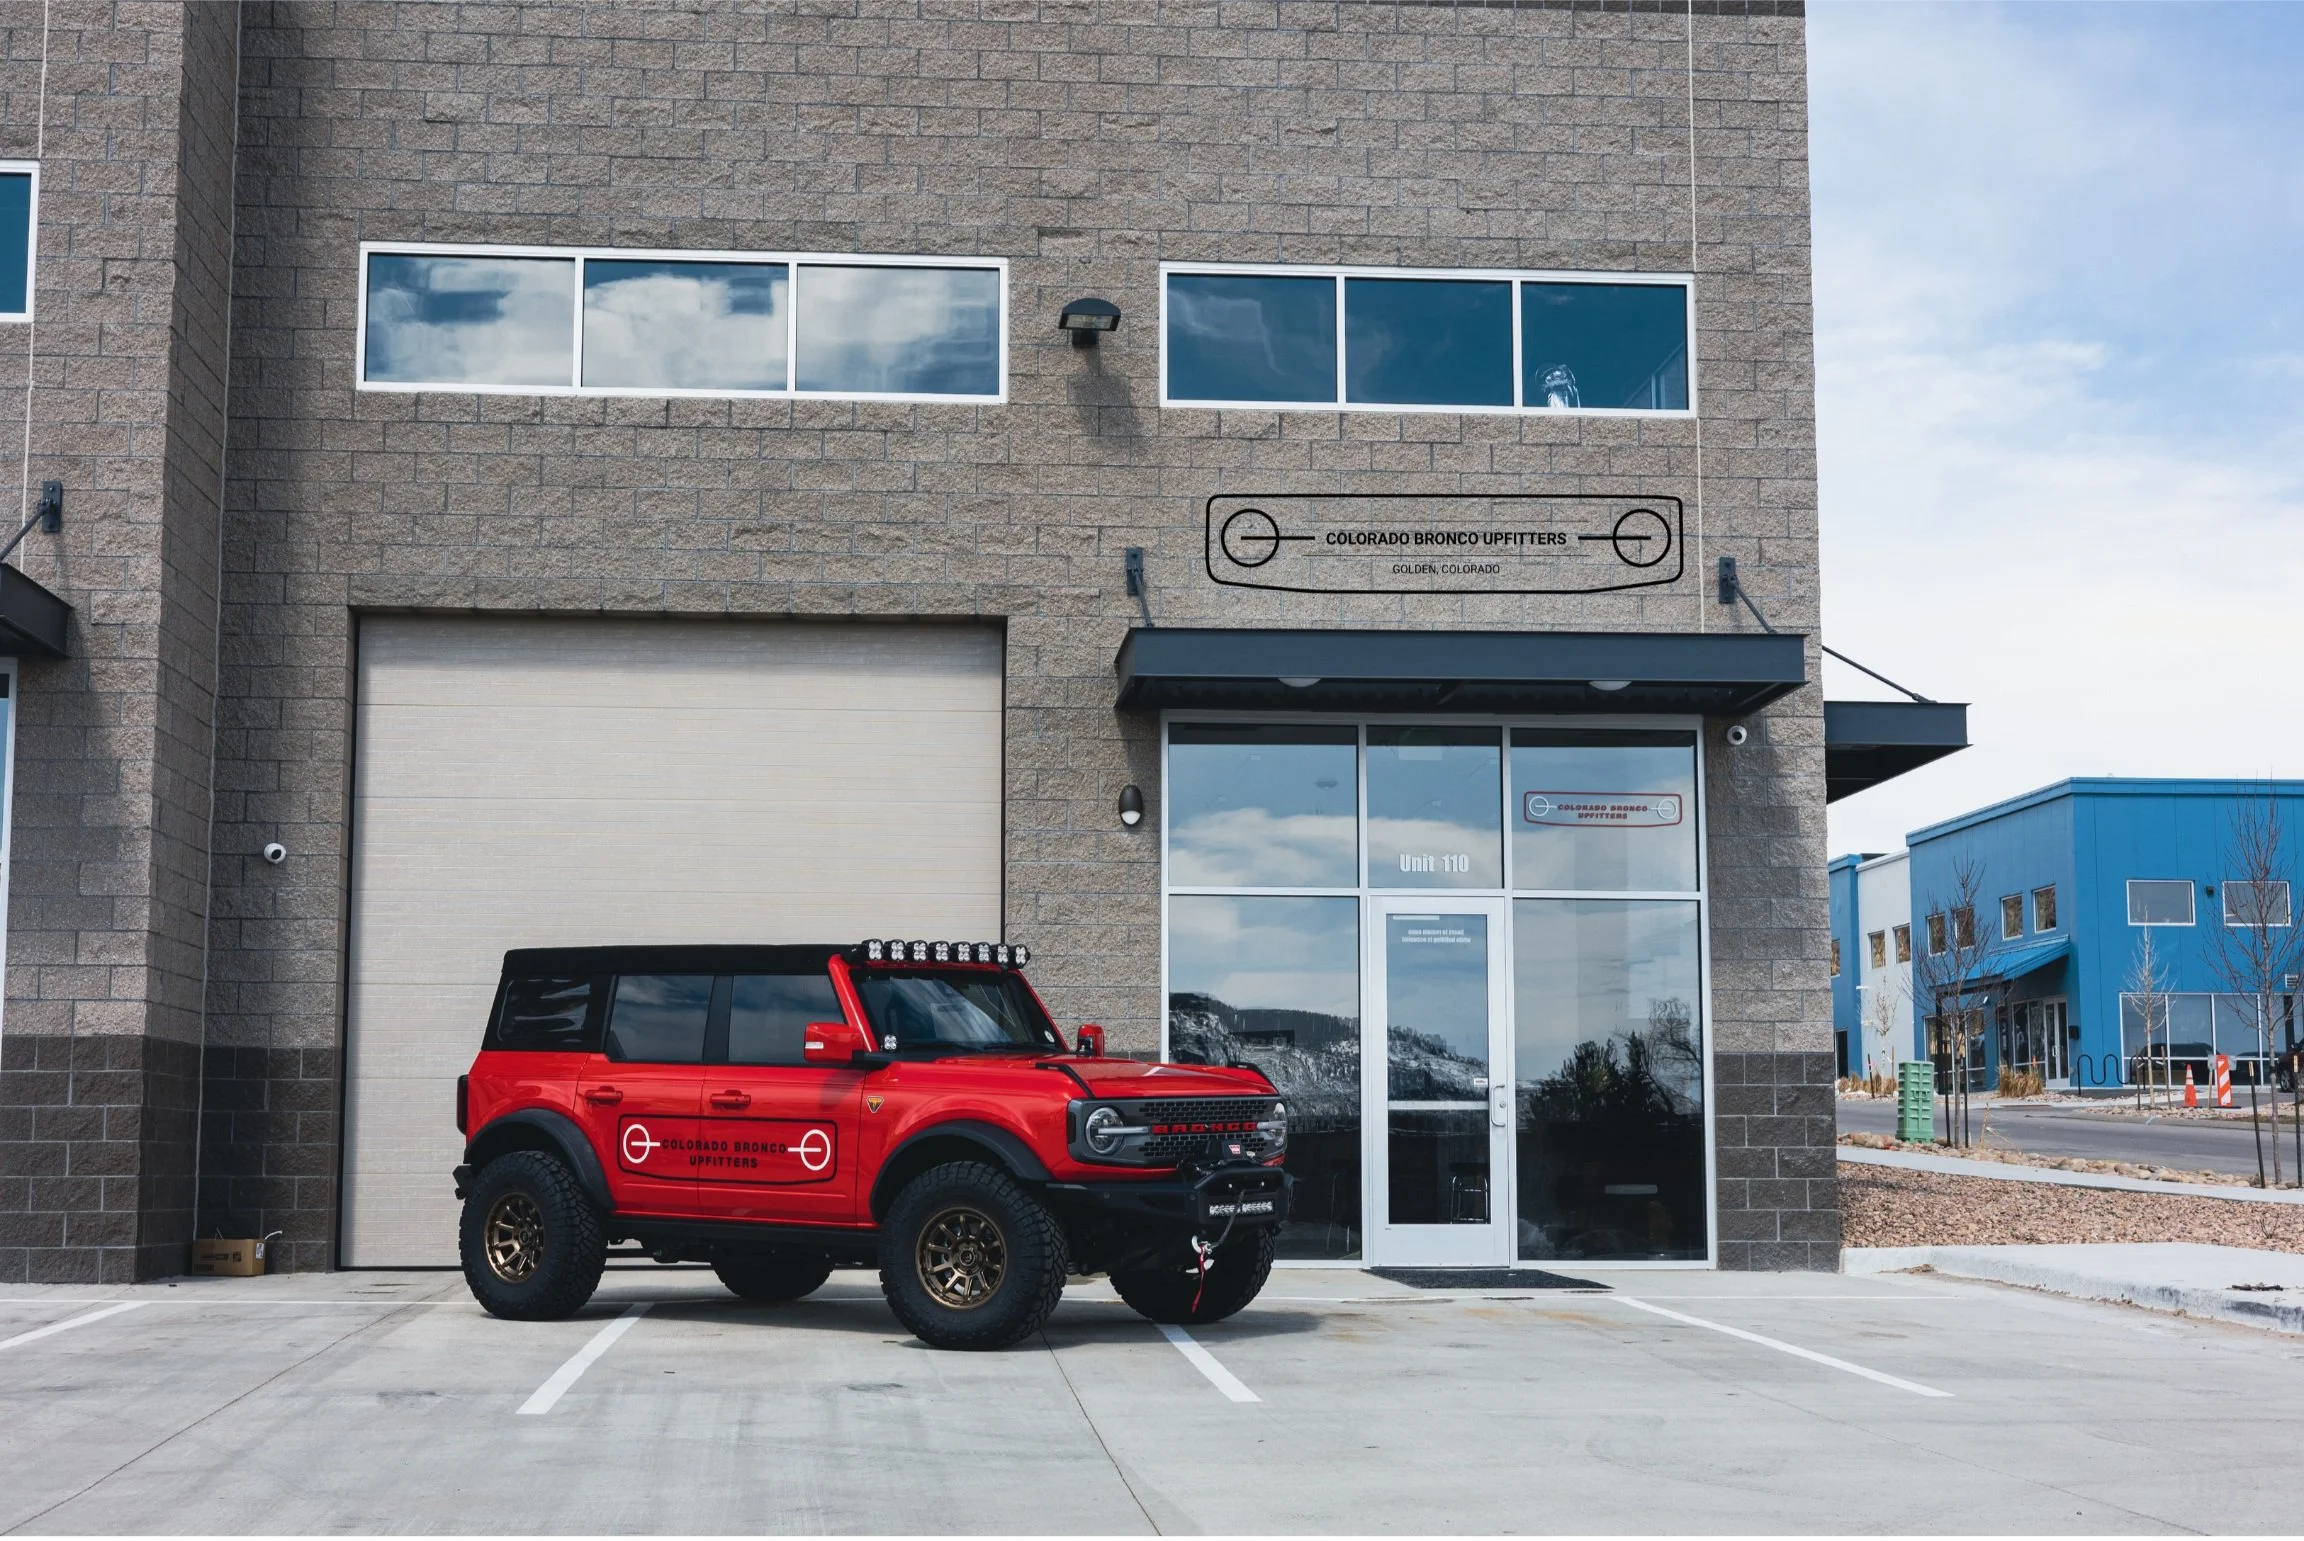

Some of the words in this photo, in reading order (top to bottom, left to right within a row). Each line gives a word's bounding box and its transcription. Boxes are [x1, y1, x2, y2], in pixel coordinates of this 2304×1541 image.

[1326, 532, 1410, 545] COLORADO
[1414, 532, 1479, 545] BRONCO
[1483, 532, 1567, 545] UPFITTERS
[1392, 564, 1439, 575] GOLDEN,
[1441, 564, 1500, 574] COLORADO
[1577, 812, 1628, 820] UPFITTERS
[1399, 853, 1435, 872] Unit
[1441, 853, 1469, 872] 110
[1152, 1121, 1258, 1135] BRONCO
[661, 1138, 728, 1152] COLORADO
[733, 1140, 787, 1154] BRONCO
[689, 1155, 758, 1169] UPFITTERS
